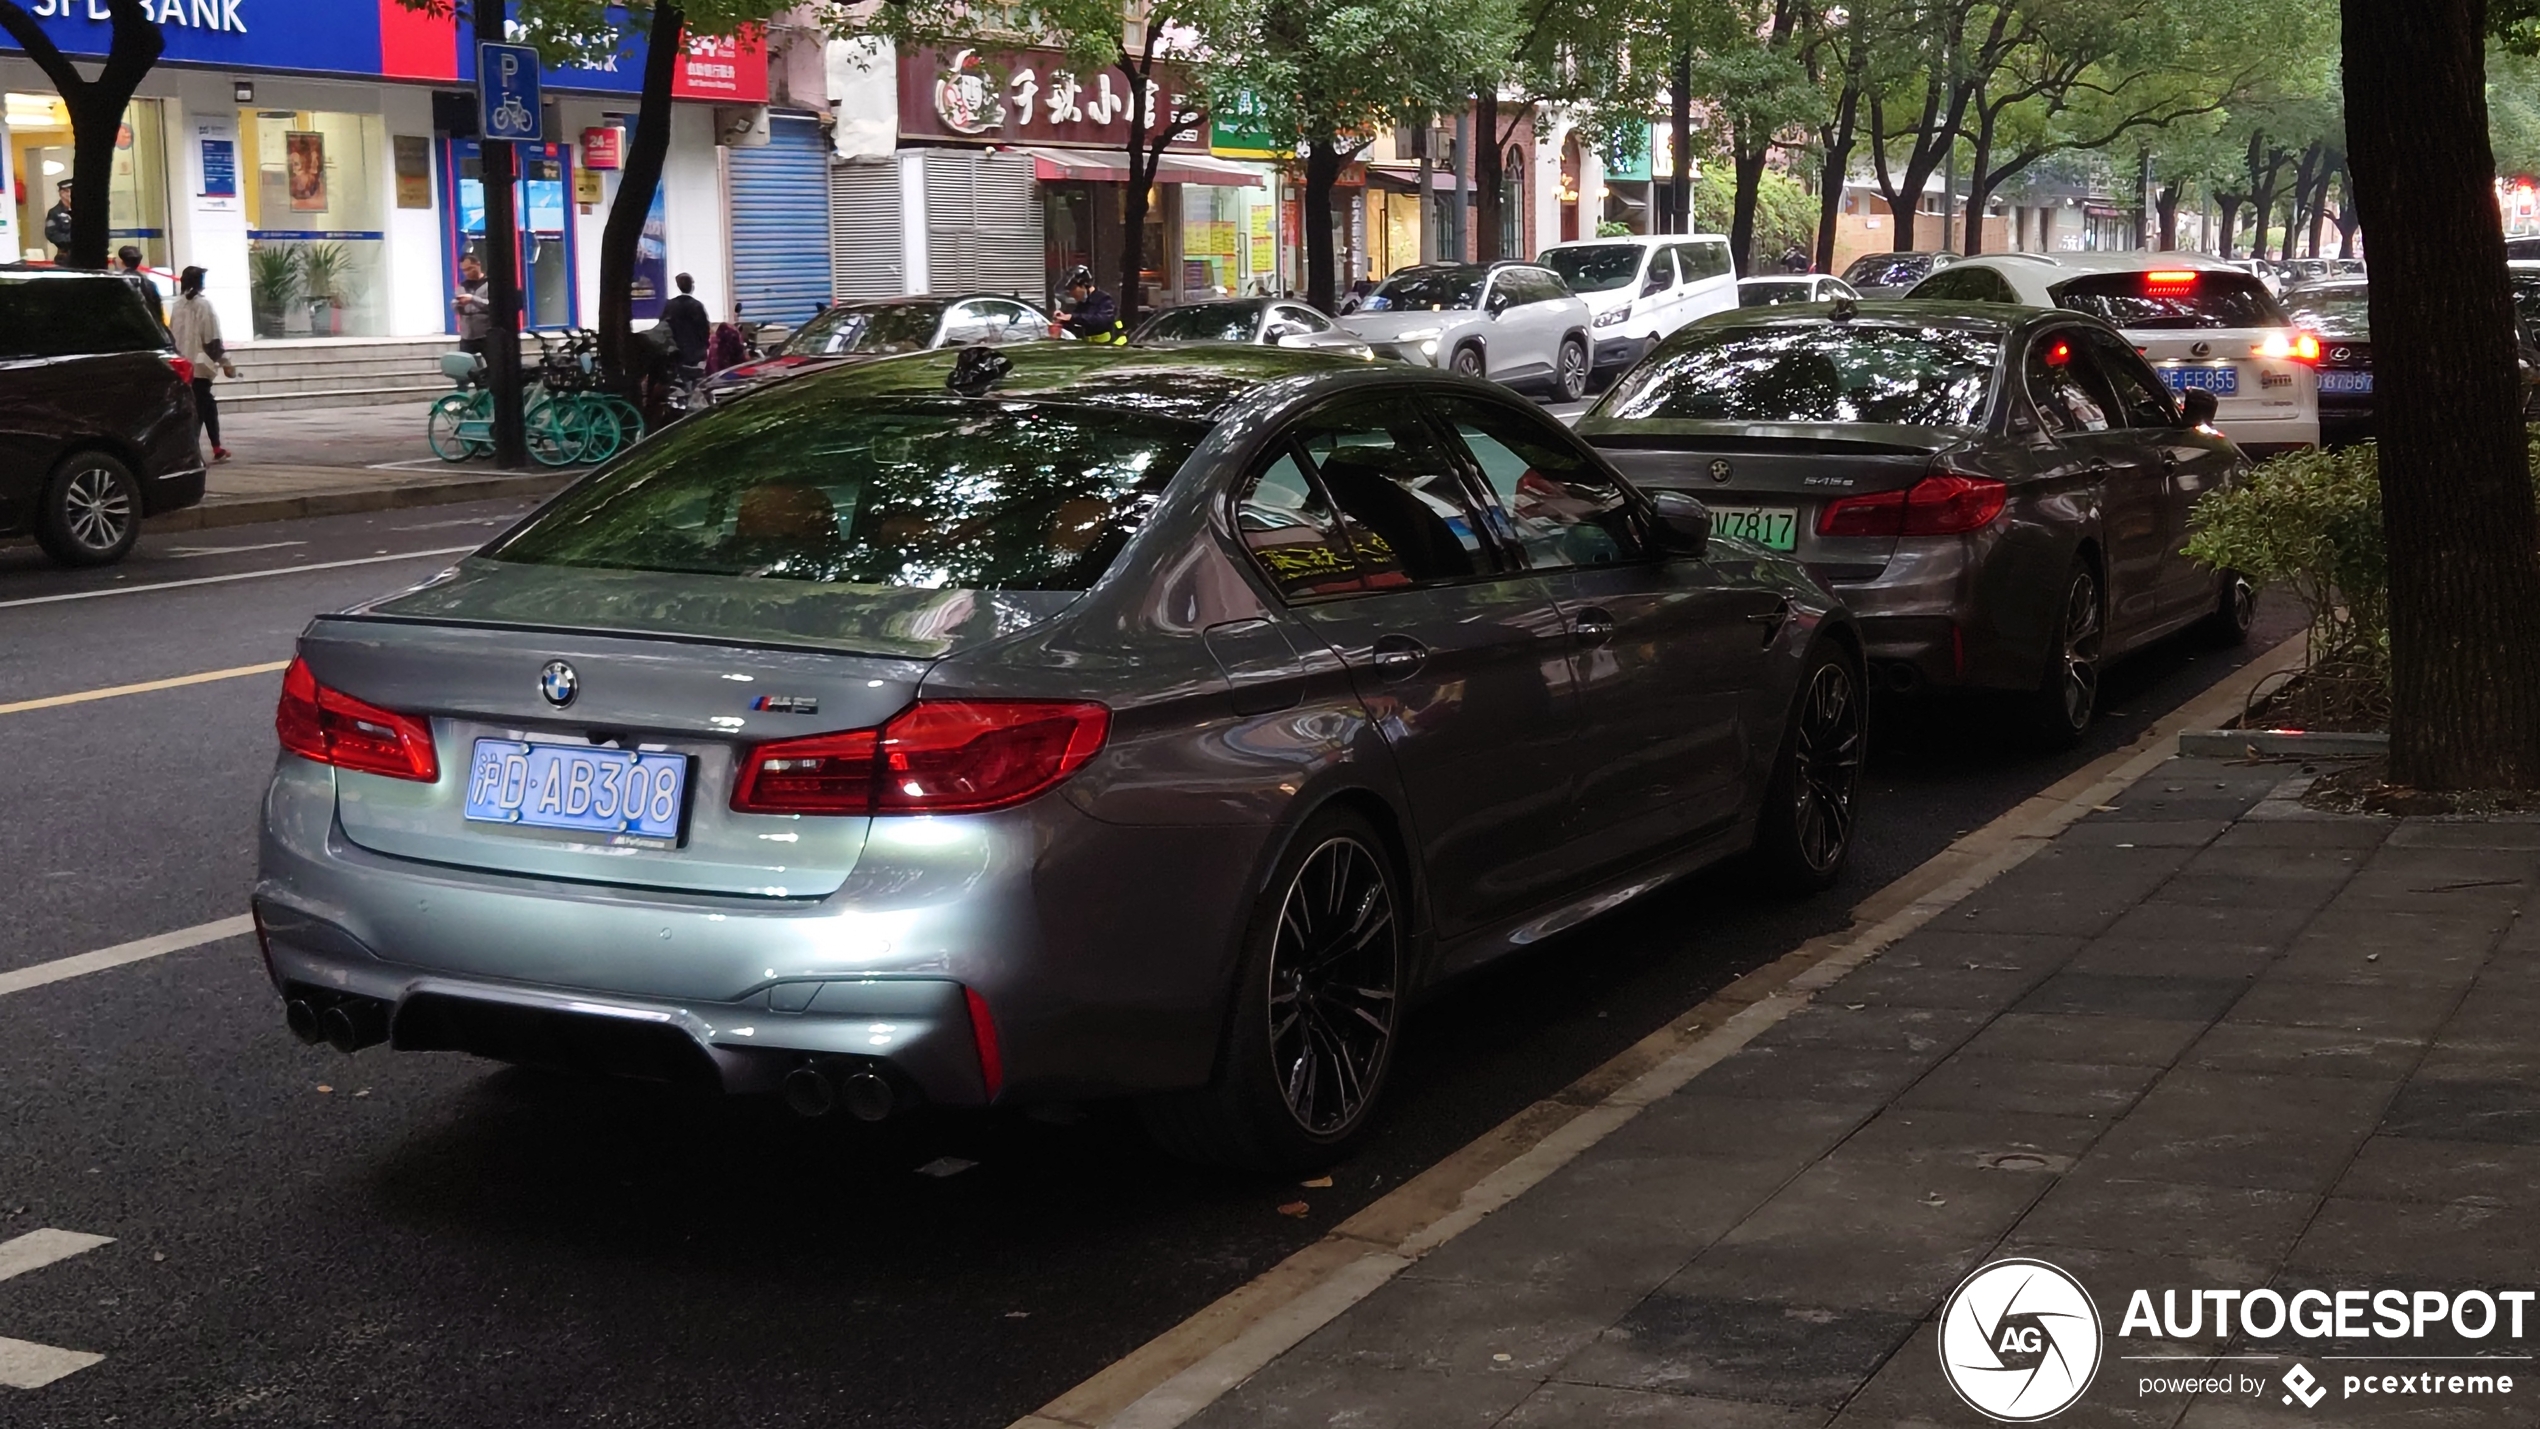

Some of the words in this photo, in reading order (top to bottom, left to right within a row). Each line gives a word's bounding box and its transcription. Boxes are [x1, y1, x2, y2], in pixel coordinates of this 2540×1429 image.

[501, 53, 518, 87] P
[589, 134, 604, 148] 24
[1709, 511, 1793, 543] V7817
[473, 753, 678, 823] 沪D·AB308
